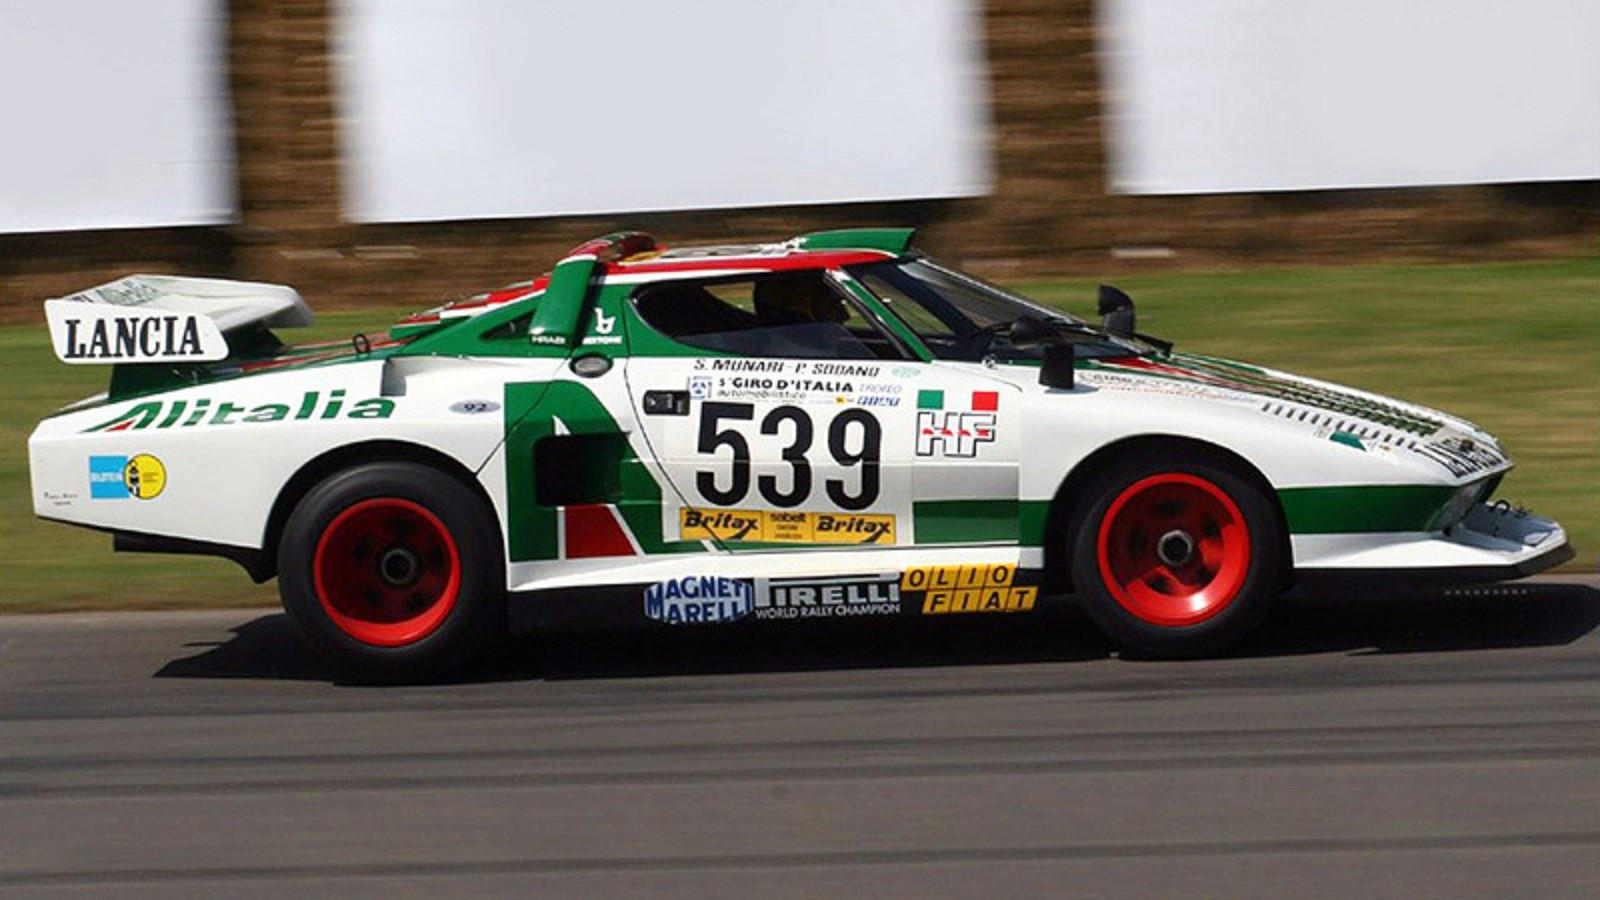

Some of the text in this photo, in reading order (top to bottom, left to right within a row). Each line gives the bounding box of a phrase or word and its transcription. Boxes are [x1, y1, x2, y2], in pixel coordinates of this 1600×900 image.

[64, 316, 204, 359] LANCIA
[712, 359, 784, 372] MUNARI
[732, 377, 773, 389] GIRO
[776, 379, 853, 393] D'ITALIA
[78, 389, 396, 434] Alitalia
[463, 403, 487, 411] 92
[915, 411, 997, 457] HF
[696, 401, 882, 510] 539
[684, 511, 759, 540] Britax
[816, 515, 890, 543] Britax
[645, 576, 751, 601] MAGNETI
[754, 571, 900, 607] PIRELLI
[909, 566, 1009, 587] OLIO
[645, 600, 751, 623] MARELLI
[755, 603, 900, 619] WORLD RALLY CHAMPION
[929, 590, 1030, 612] FIAT
